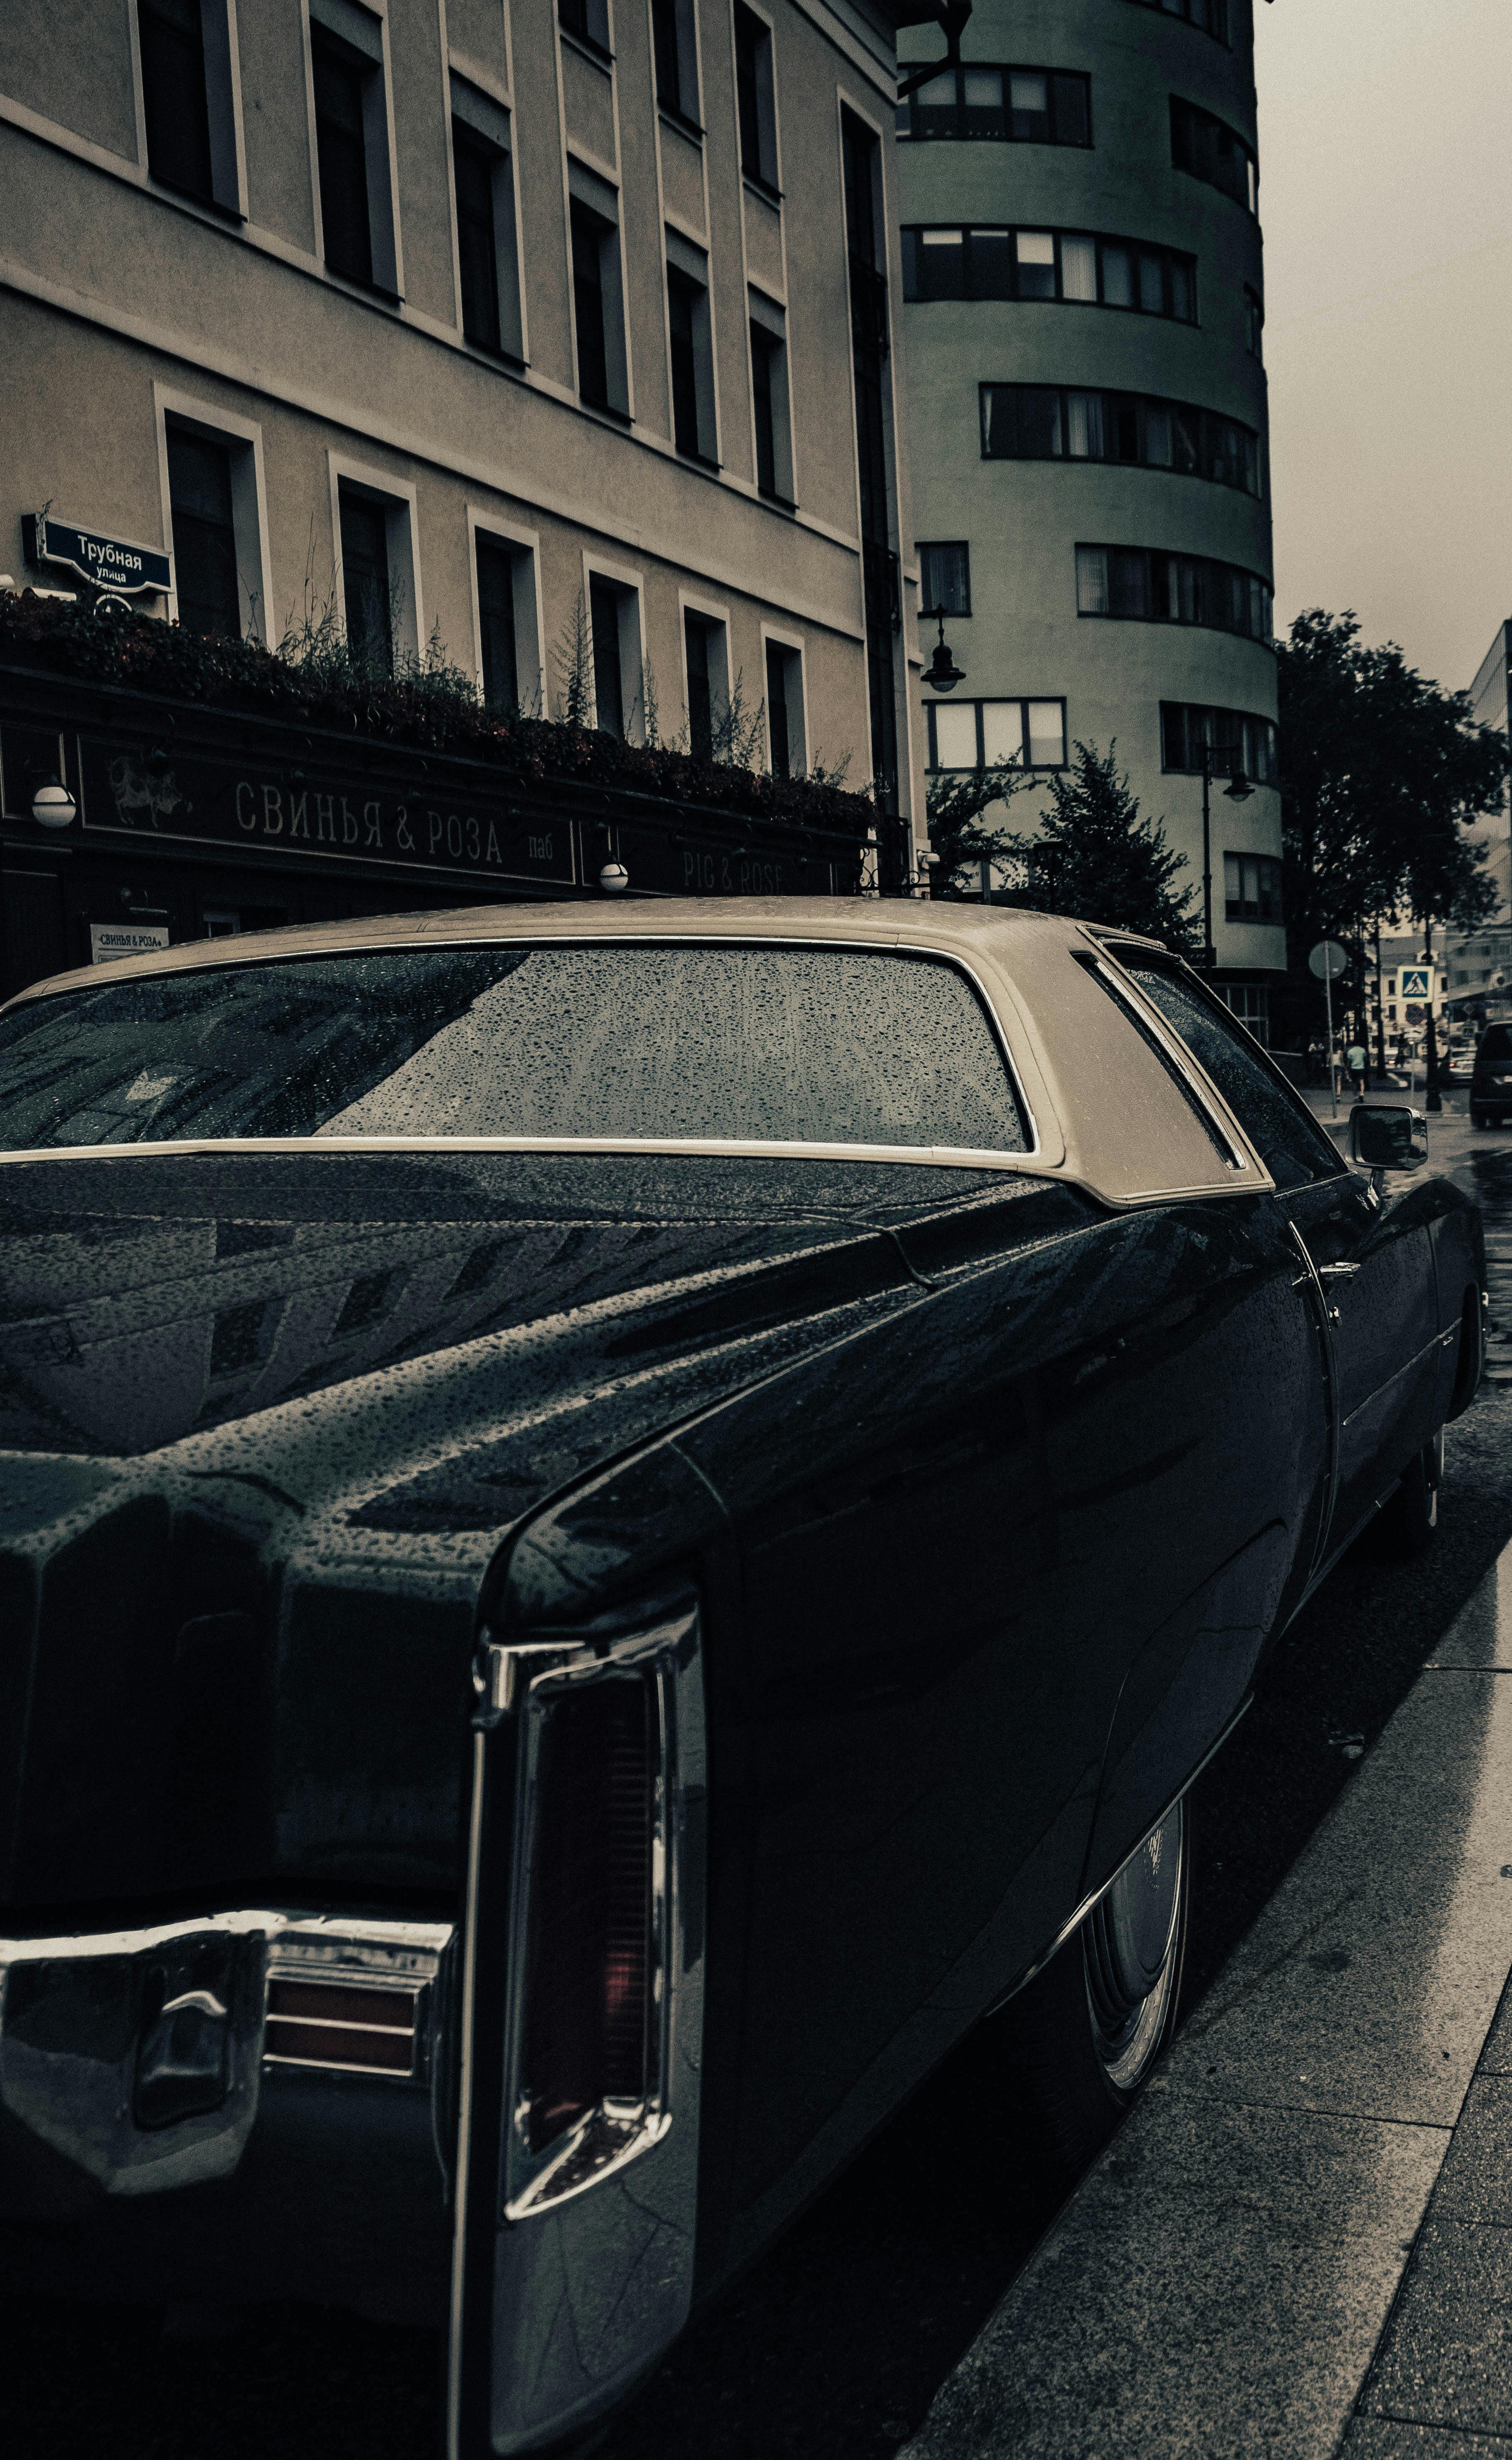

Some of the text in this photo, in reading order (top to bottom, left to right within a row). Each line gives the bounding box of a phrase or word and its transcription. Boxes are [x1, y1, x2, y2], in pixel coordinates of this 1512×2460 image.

[78, 535, 142, 571] Трубная
[96, 566, 126, 583] улица
[236, 781, 553, 864] СВИНЬЯ & РОЗА паб
[683, 852, 714, 888] PIG
[100, 934, 131, 946] СВИНЬЯ
[139, 935, 157, 947] РОЗА
